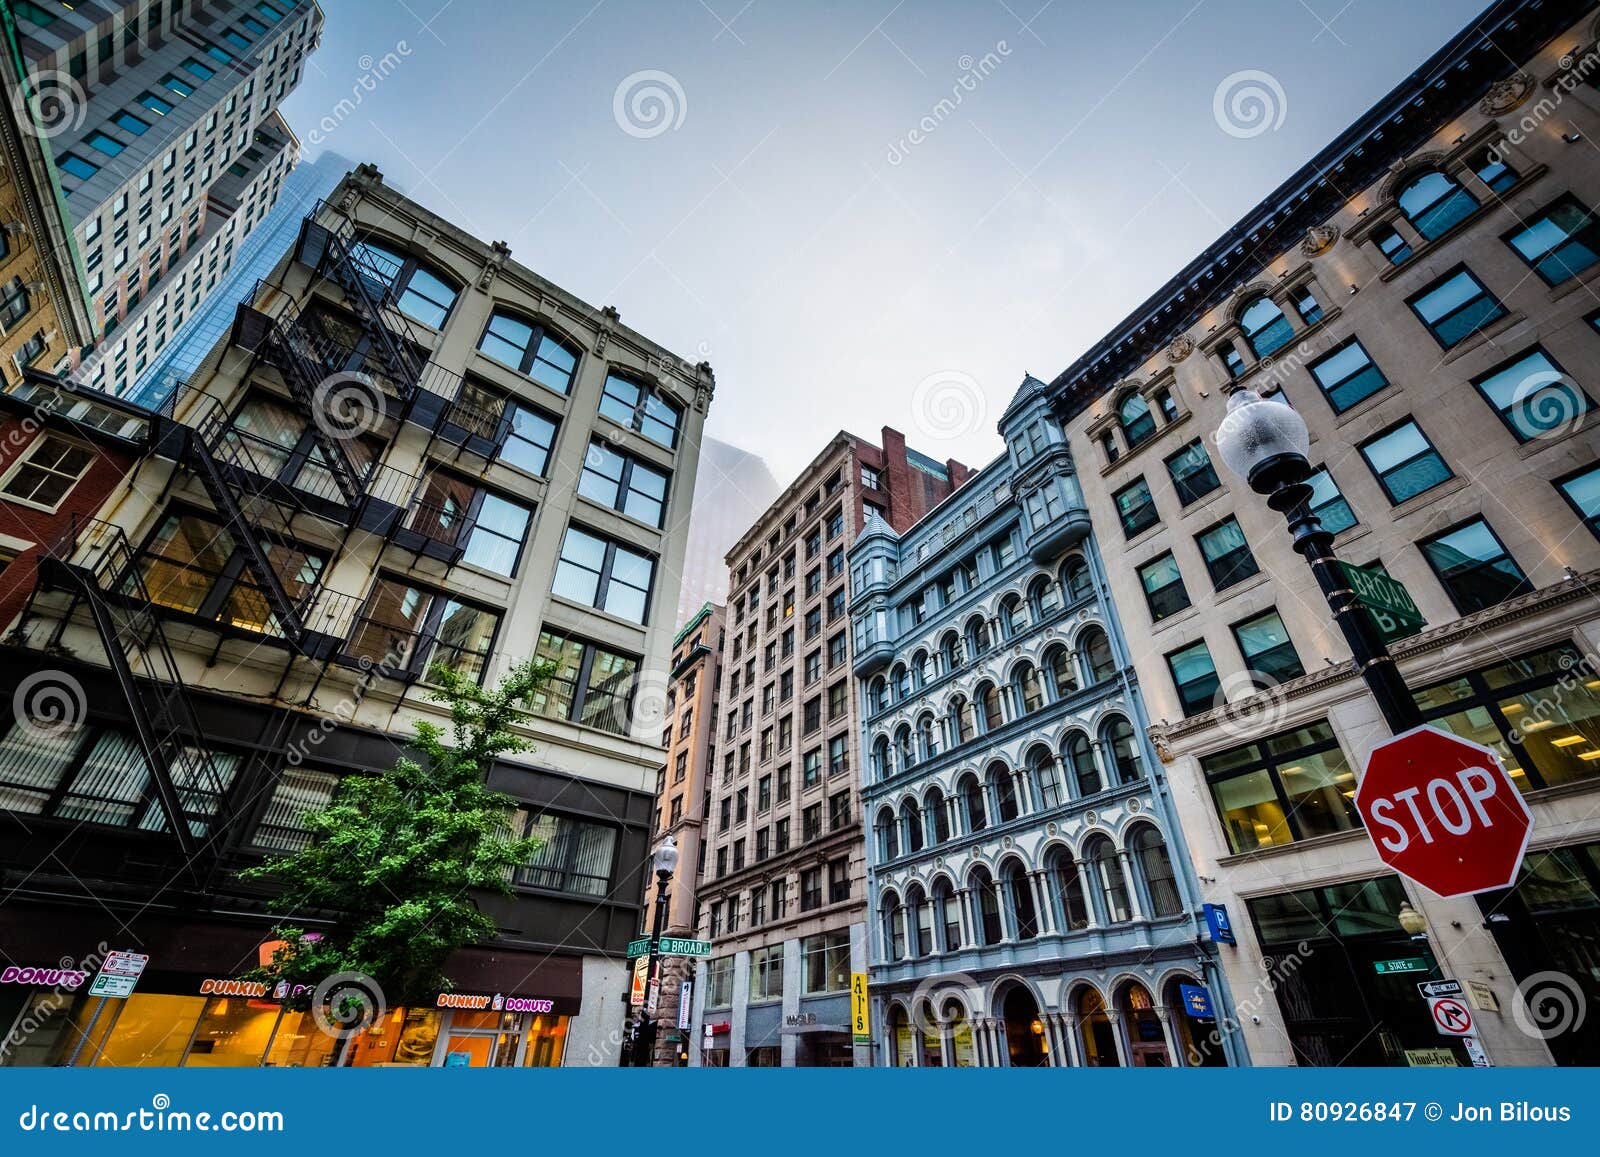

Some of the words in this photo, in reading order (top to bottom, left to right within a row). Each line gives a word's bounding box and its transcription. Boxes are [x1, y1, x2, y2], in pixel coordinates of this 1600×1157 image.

[1348, 567, 1415, 613] BROAD
[1370, 765, 1497, 853] STOP
[633, 941, 648, 955] STATE
[671, 940, 702, 954] BROAD
[1388, 960, 1408, 971] STATE
[1, 966, 87, 987] DONUTS
[200, 979, 271, 998] DUNKIN'
[1431, 984, 1443, 993] ONE
[1445, 983, 1457, 991] WAY
[437, 993, 491, 1009] DUNKIN'
[506, 998, 552, 1013] DONUTS
[1407, 1052, 1455, 1065] Visual-Eyes
